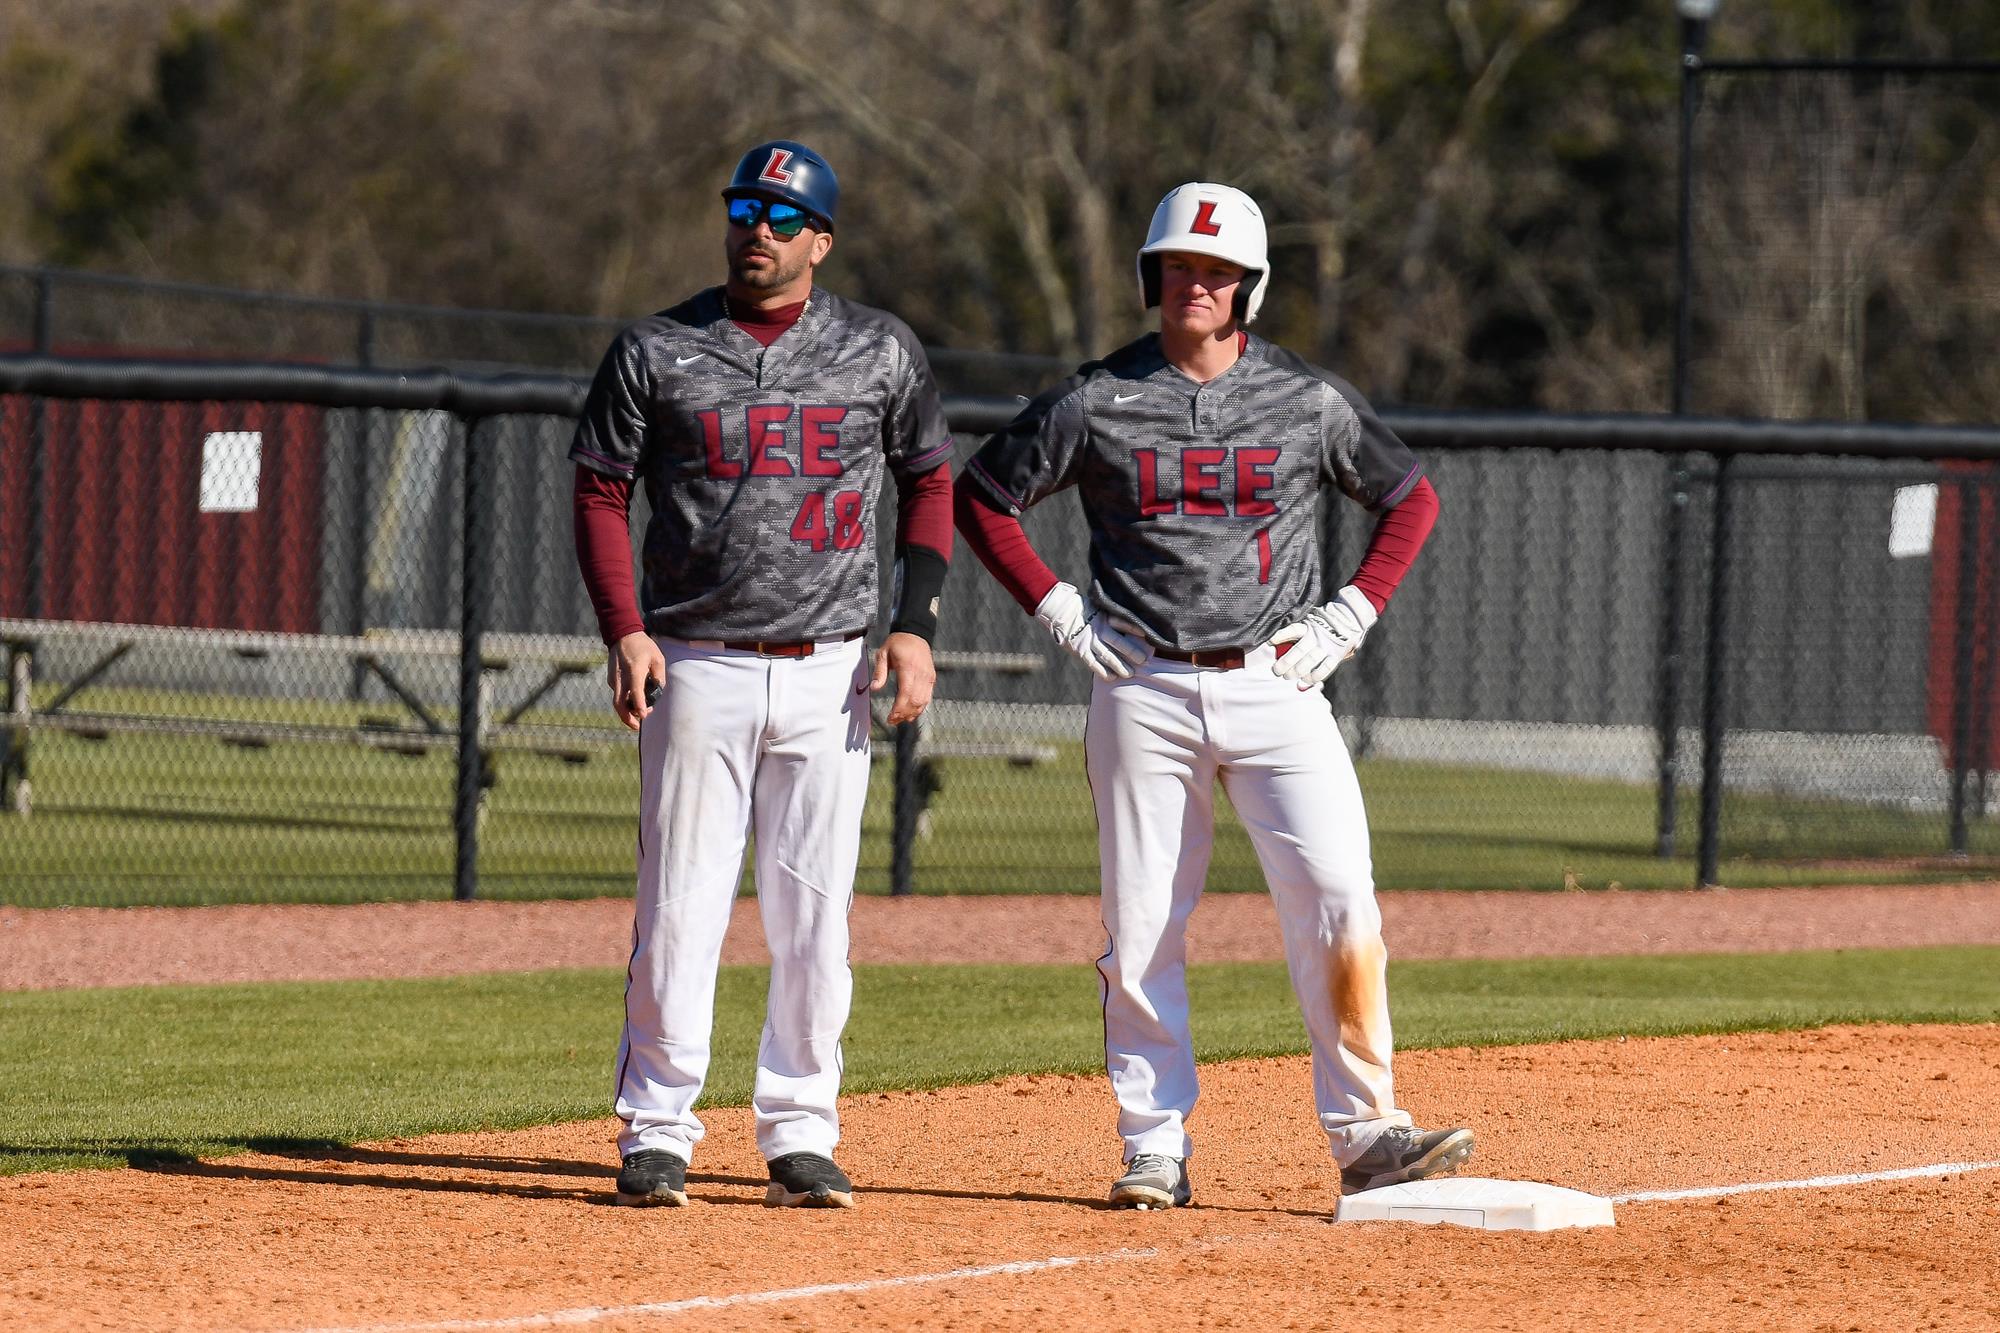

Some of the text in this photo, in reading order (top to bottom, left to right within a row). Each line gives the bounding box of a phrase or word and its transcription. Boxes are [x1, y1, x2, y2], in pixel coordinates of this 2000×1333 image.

[758, 148, 793, 185] L
[1189, 200, 1222, 237] L
[695, 403, 850, 480] LEE
[1132, 446, 1282, 518] LEE
[790, 490, 865, 553] 48
[1252, 527, 1272, 585] 1
